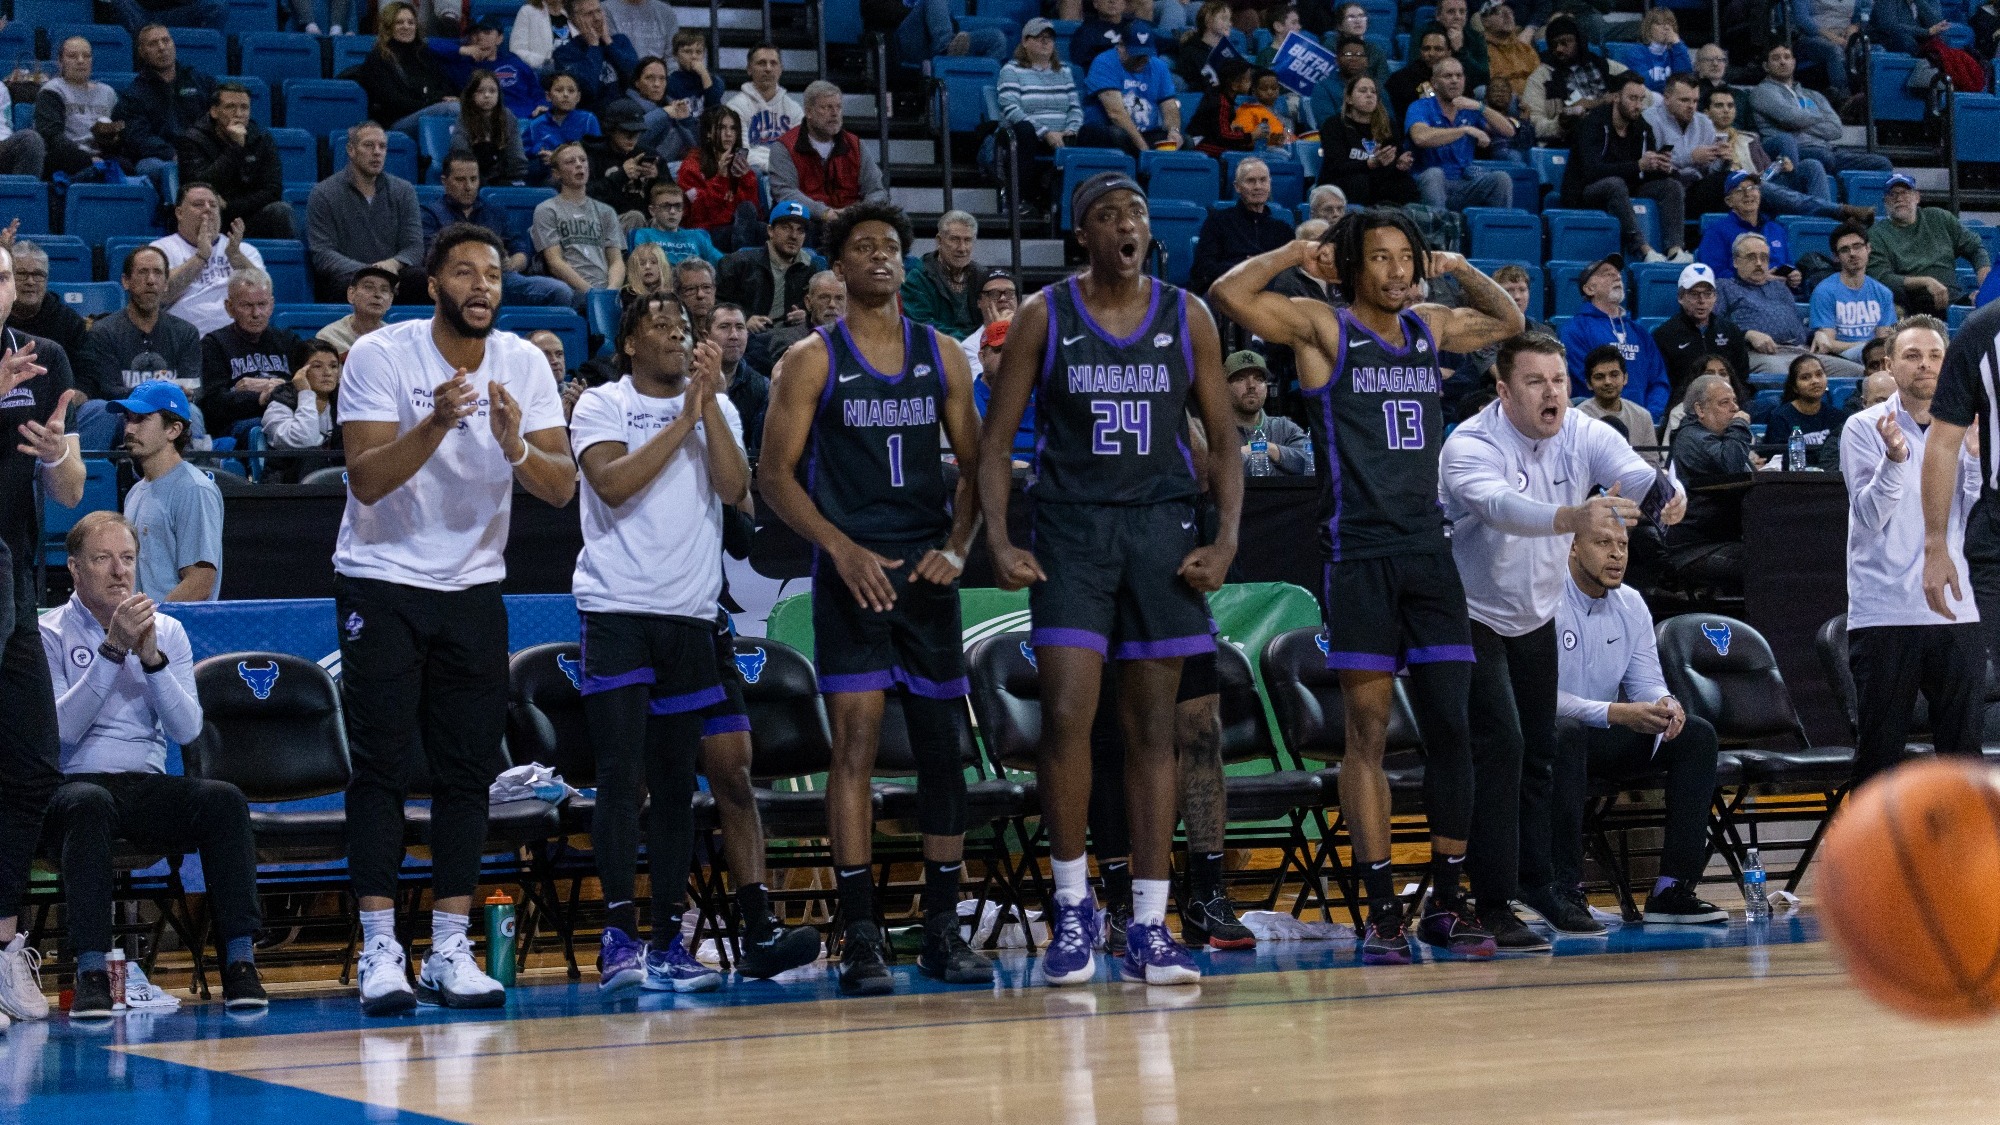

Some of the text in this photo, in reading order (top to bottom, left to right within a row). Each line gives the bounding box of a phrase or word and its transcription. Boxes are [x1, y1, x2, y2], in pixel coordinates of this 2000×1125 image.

[1287, 43, 1335, 77] BUFFAL
[1067, 365, 1171, 393] NIAGARA
[1352, 366, 1437, 393] NIAGARA
[843, 396, 937, 427] NIAGARA
[1091, 400, 1151, 455] 24
[1382, 400, 1425, 450] 13
[886, 433, 905, 487] 1
